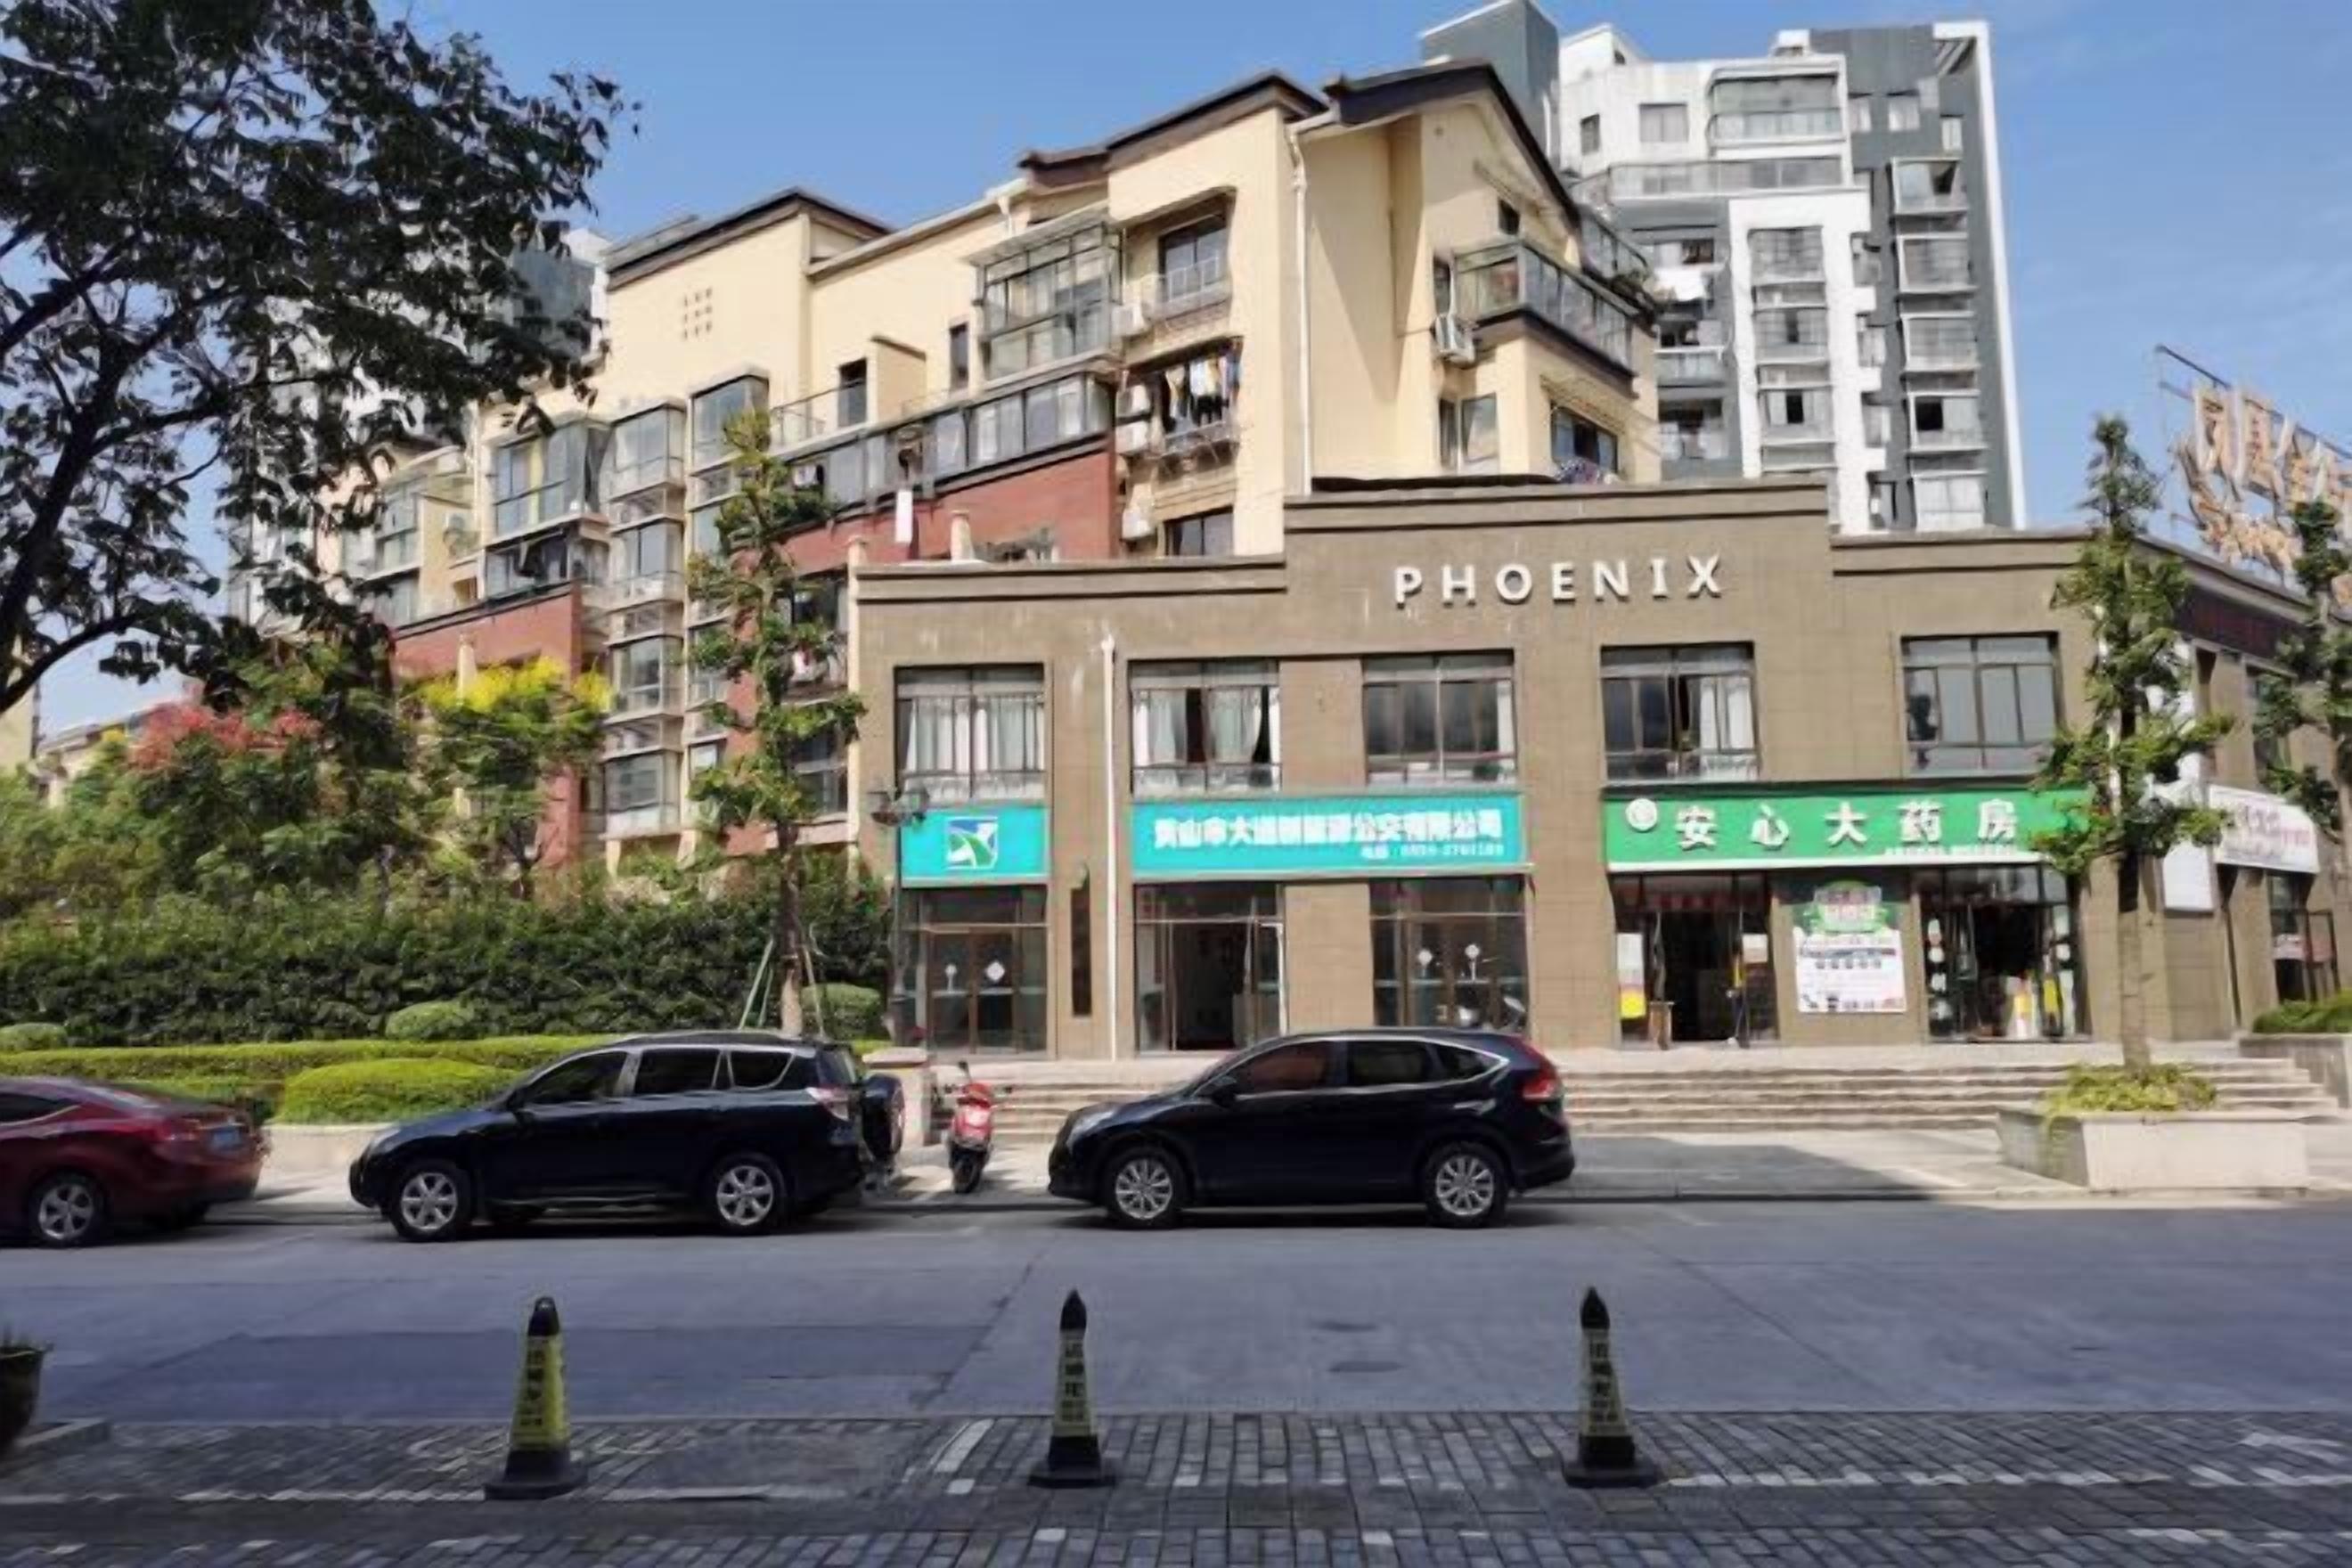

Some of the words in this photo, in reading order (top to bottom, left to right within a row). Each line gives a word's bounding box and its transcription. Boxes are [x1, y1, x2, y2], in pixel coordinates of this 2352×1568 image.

[1394, 553, 1721, 608] PHOENIX
[1675, 799, 2017, 850] 安心大药房
